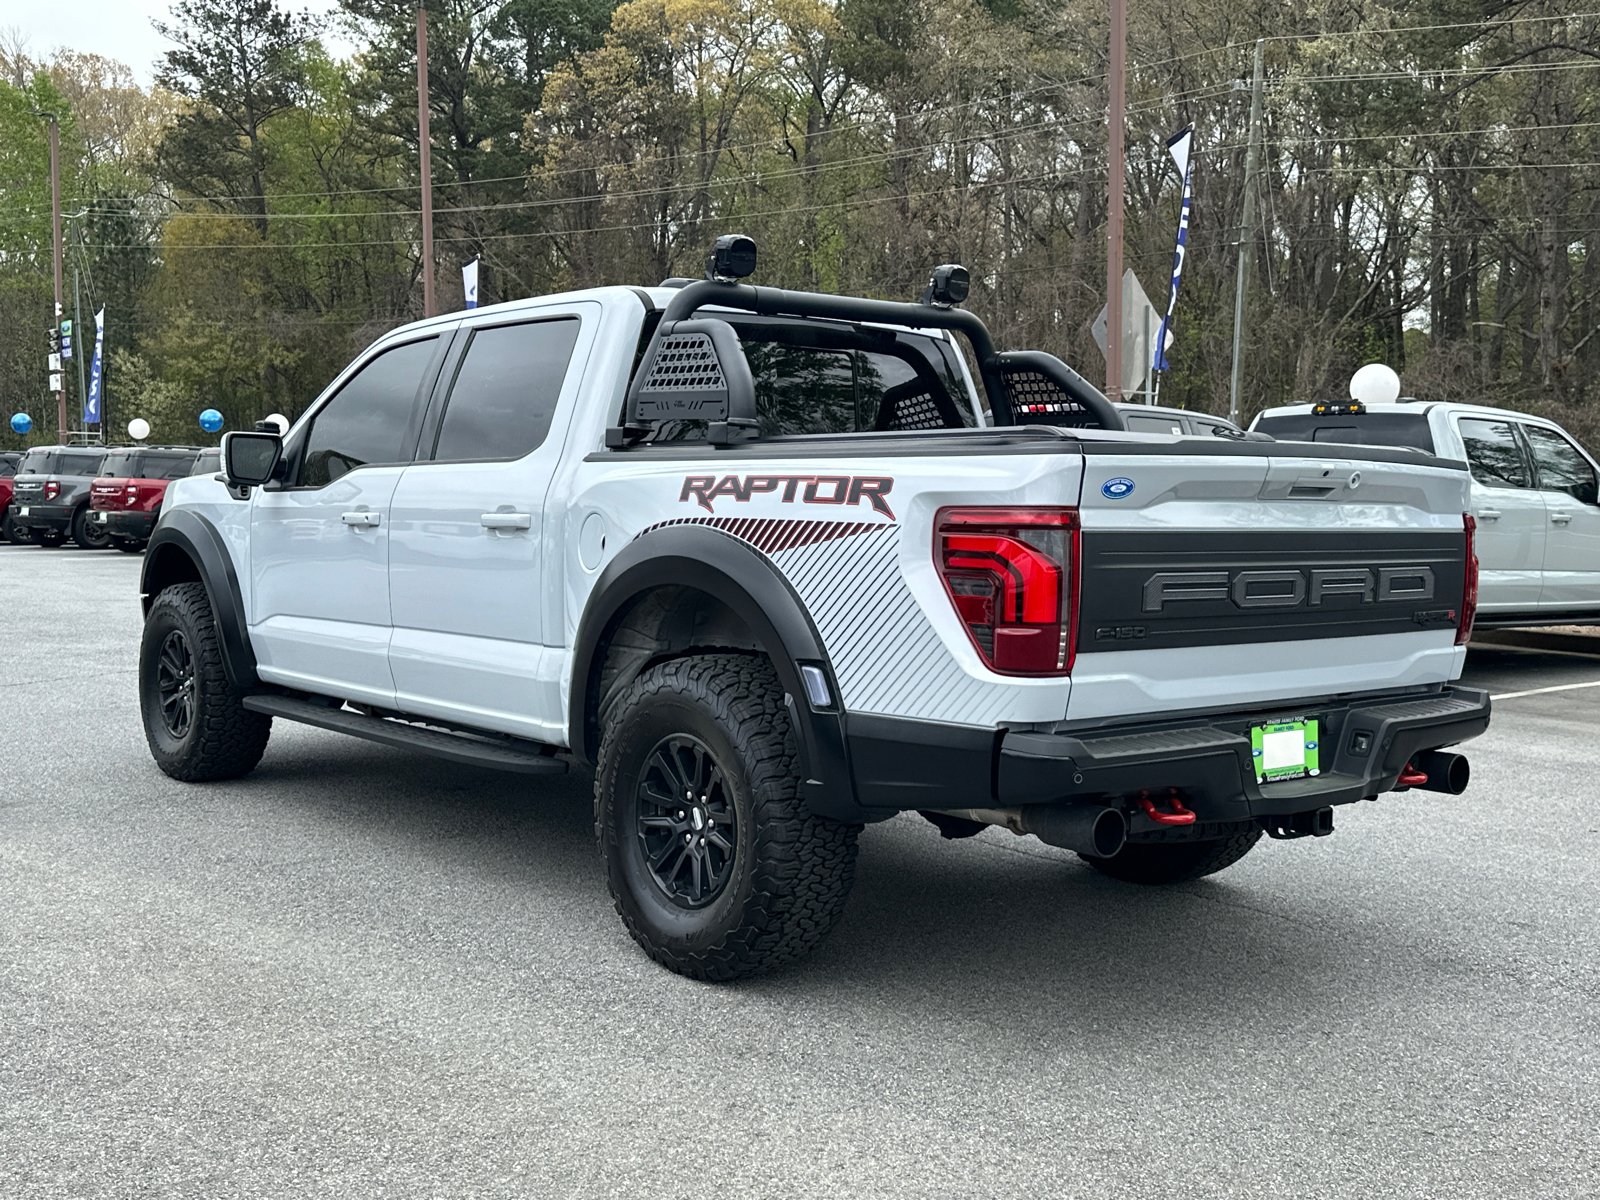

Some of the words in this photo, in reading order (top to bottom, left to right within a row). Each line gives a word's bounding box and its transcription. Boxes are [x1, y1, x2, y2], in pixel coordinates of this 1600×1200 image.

[678, 474, 896, 521] RAPTOR
[1142, 565, 1435, 613] FORD
[1095, 626, 1147, 641] F-150
